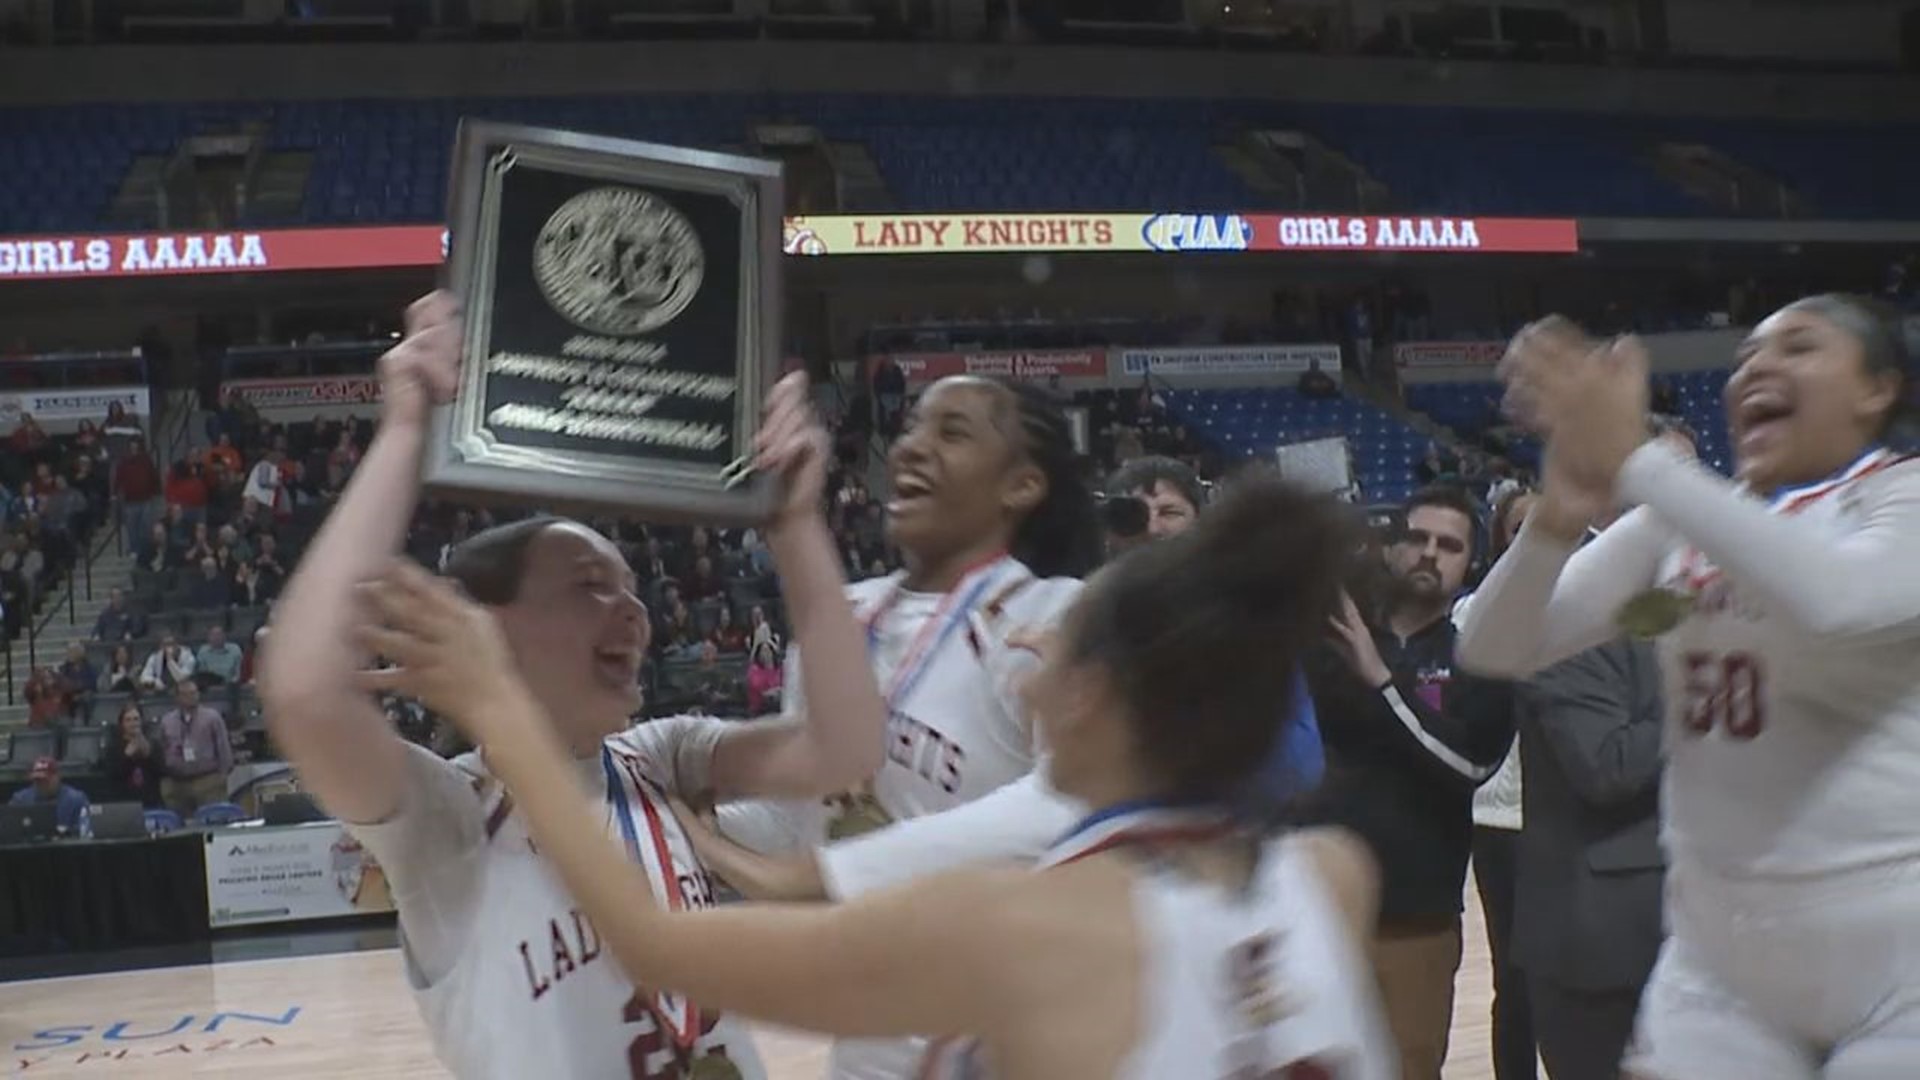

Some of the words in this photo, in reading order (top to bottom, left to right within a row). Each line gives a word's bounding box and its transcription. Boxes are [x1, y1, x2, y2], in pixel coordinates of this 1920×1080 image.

[853, 220, 951, 248] LADY
[963, 219, 1113, 246] KNIGHTS
[1151, 213, 1247, 250] PIAA
[1279, 217, 1368, 247] GIRLS
[1375, 218, 1480, 248] AAAAA
[0, 240, 110, 273] GIRLS
[121, 235, 267, 269] AAAAA
[1681, 651, 1766, 741] 50
[519, 908, 601, 1000] LAD
[14, 1005, 302, 1052] SUN
